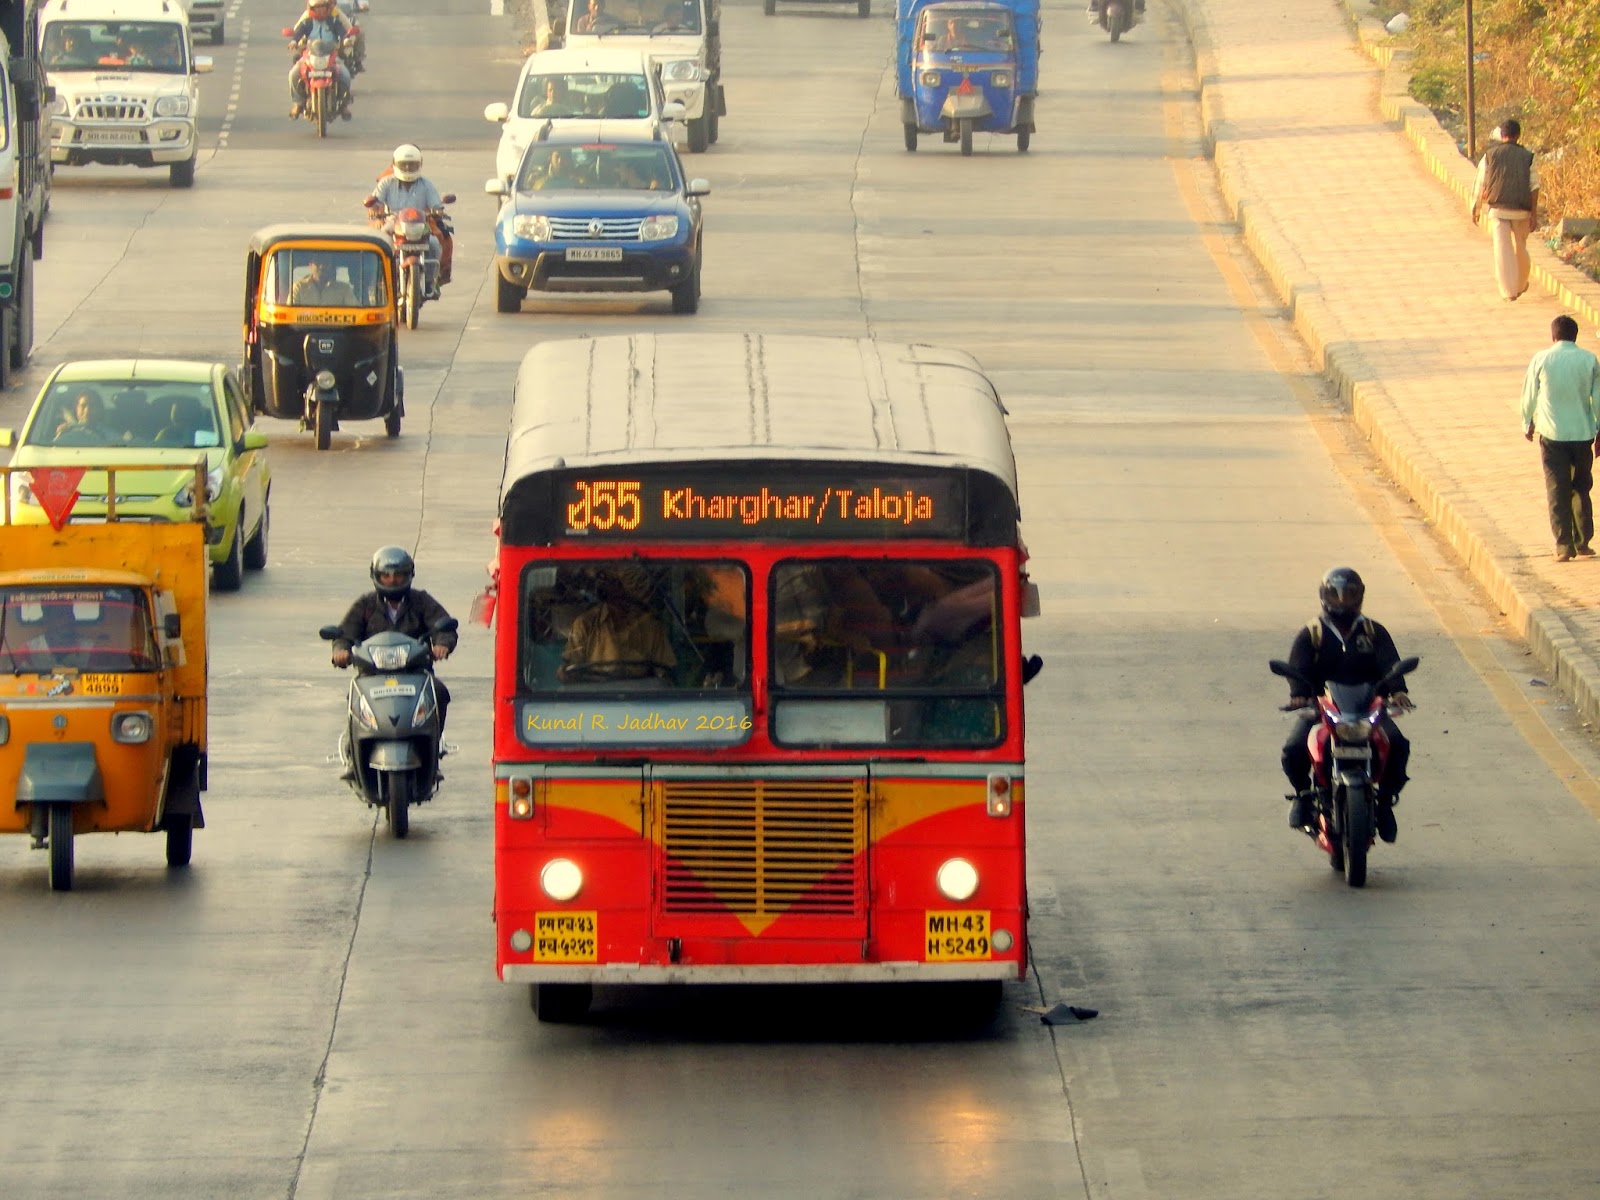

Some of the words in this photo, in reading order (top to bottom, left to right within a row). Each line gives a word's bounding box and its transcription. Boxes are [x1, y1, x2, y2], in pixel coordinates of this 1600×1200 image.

[570, 250, 581, 259] MH
[582, 250, 592, 259] 46
[662, 487, 932, 525] Kharghar/Taloja
